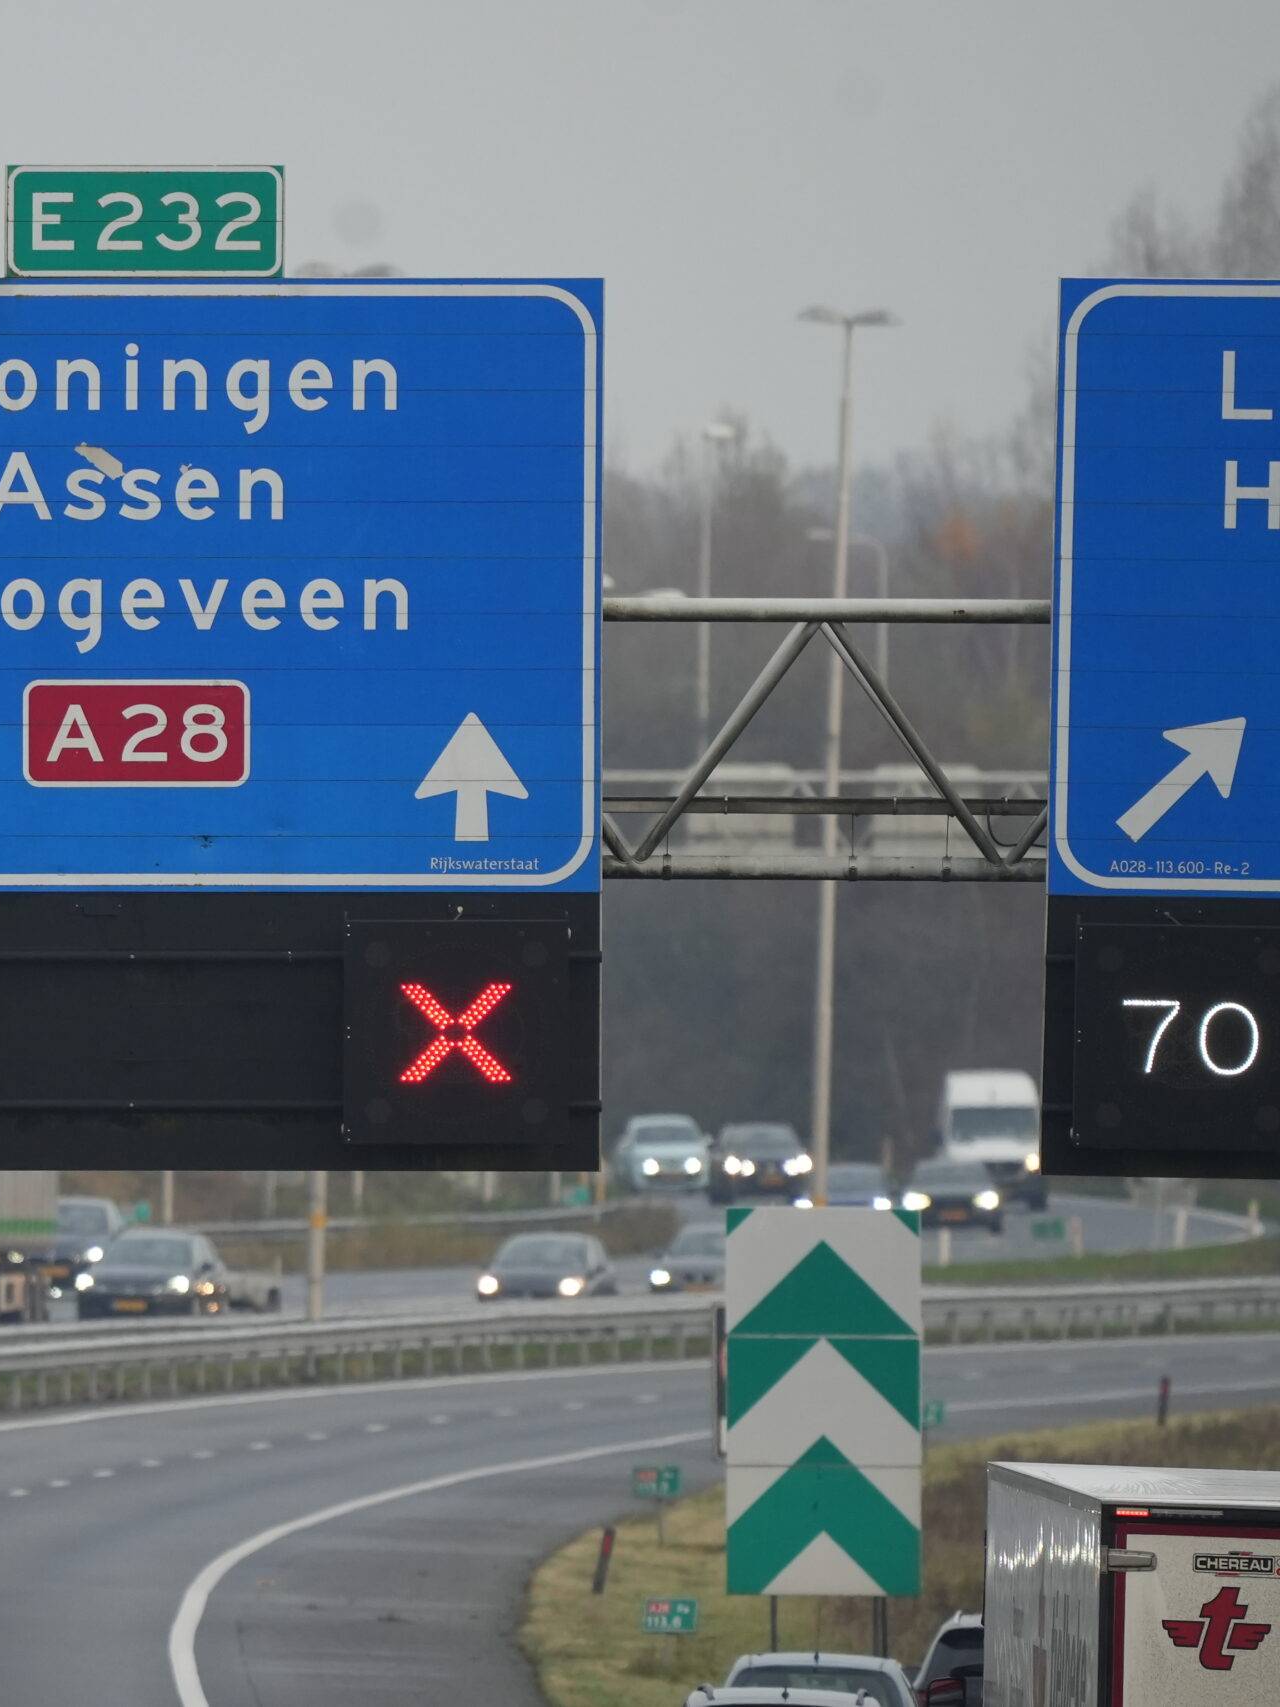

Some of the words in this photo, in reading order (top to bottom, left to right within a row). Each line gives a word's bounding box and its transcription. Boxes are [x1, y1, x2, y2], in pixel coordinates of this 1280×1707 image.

[430, 857, 540, 873] Rijkswaterstaat
[1122, 998, 1260, 1076] 70
[1196, 1556, 1272, 1572] CHEREAU
